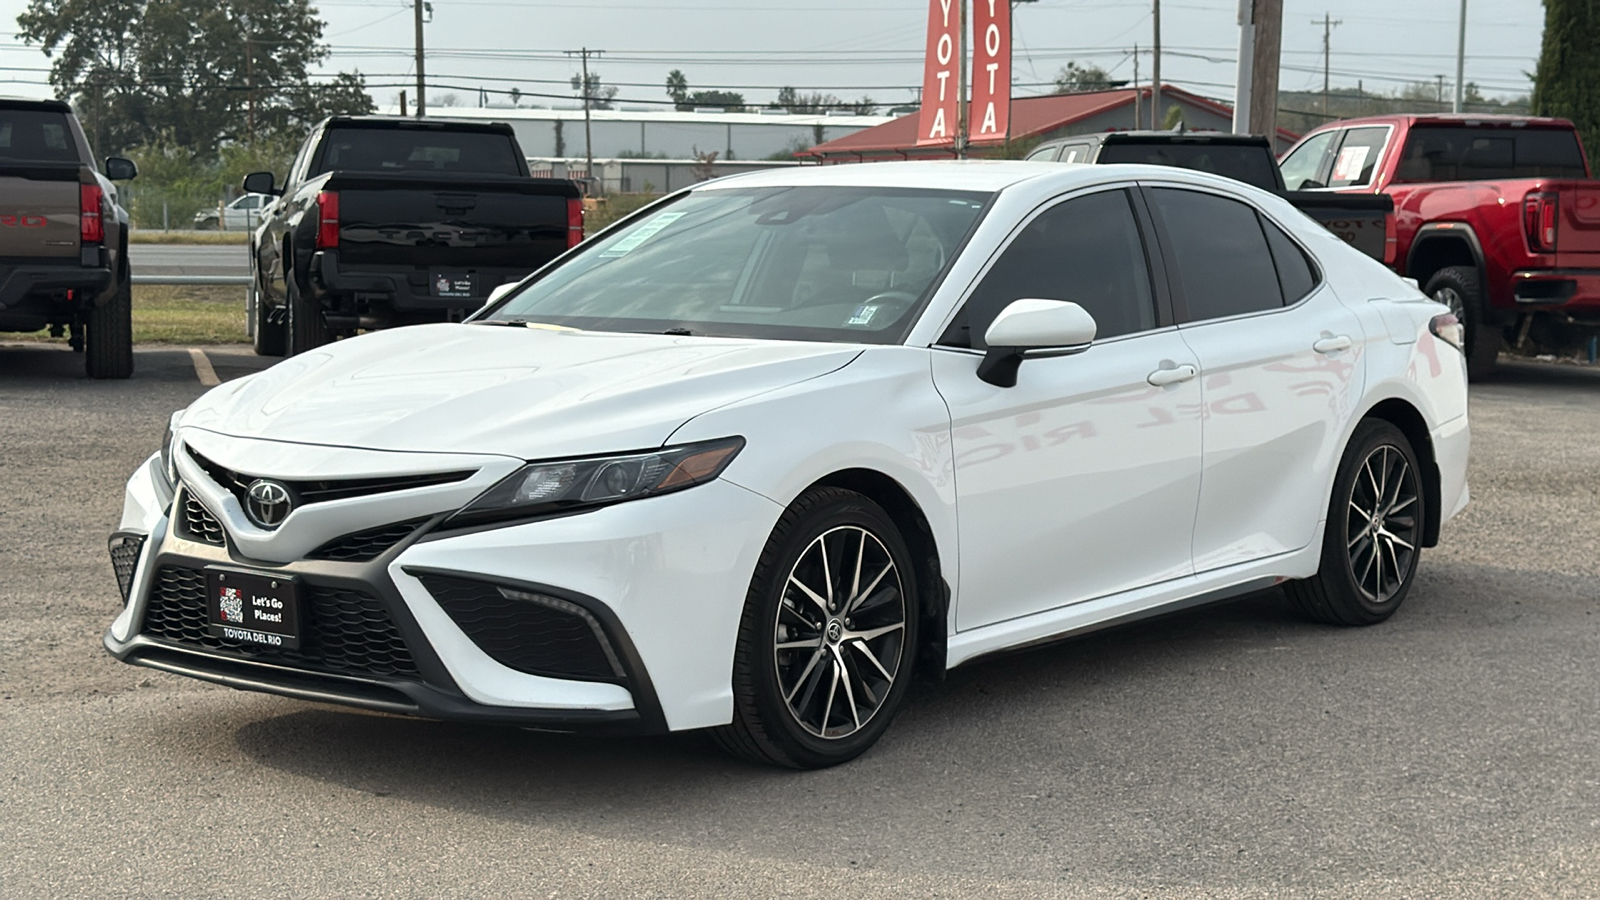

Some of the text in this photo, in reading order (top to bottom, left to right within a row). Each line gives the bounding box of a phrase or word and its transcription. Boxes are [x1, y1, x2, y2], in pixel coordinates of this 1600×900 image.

[252, 595, 283, 609] Let's Go
[254, 609, 282, 623] Places!
[223, 627, 282, 646] TOYOTA DEL RIO
